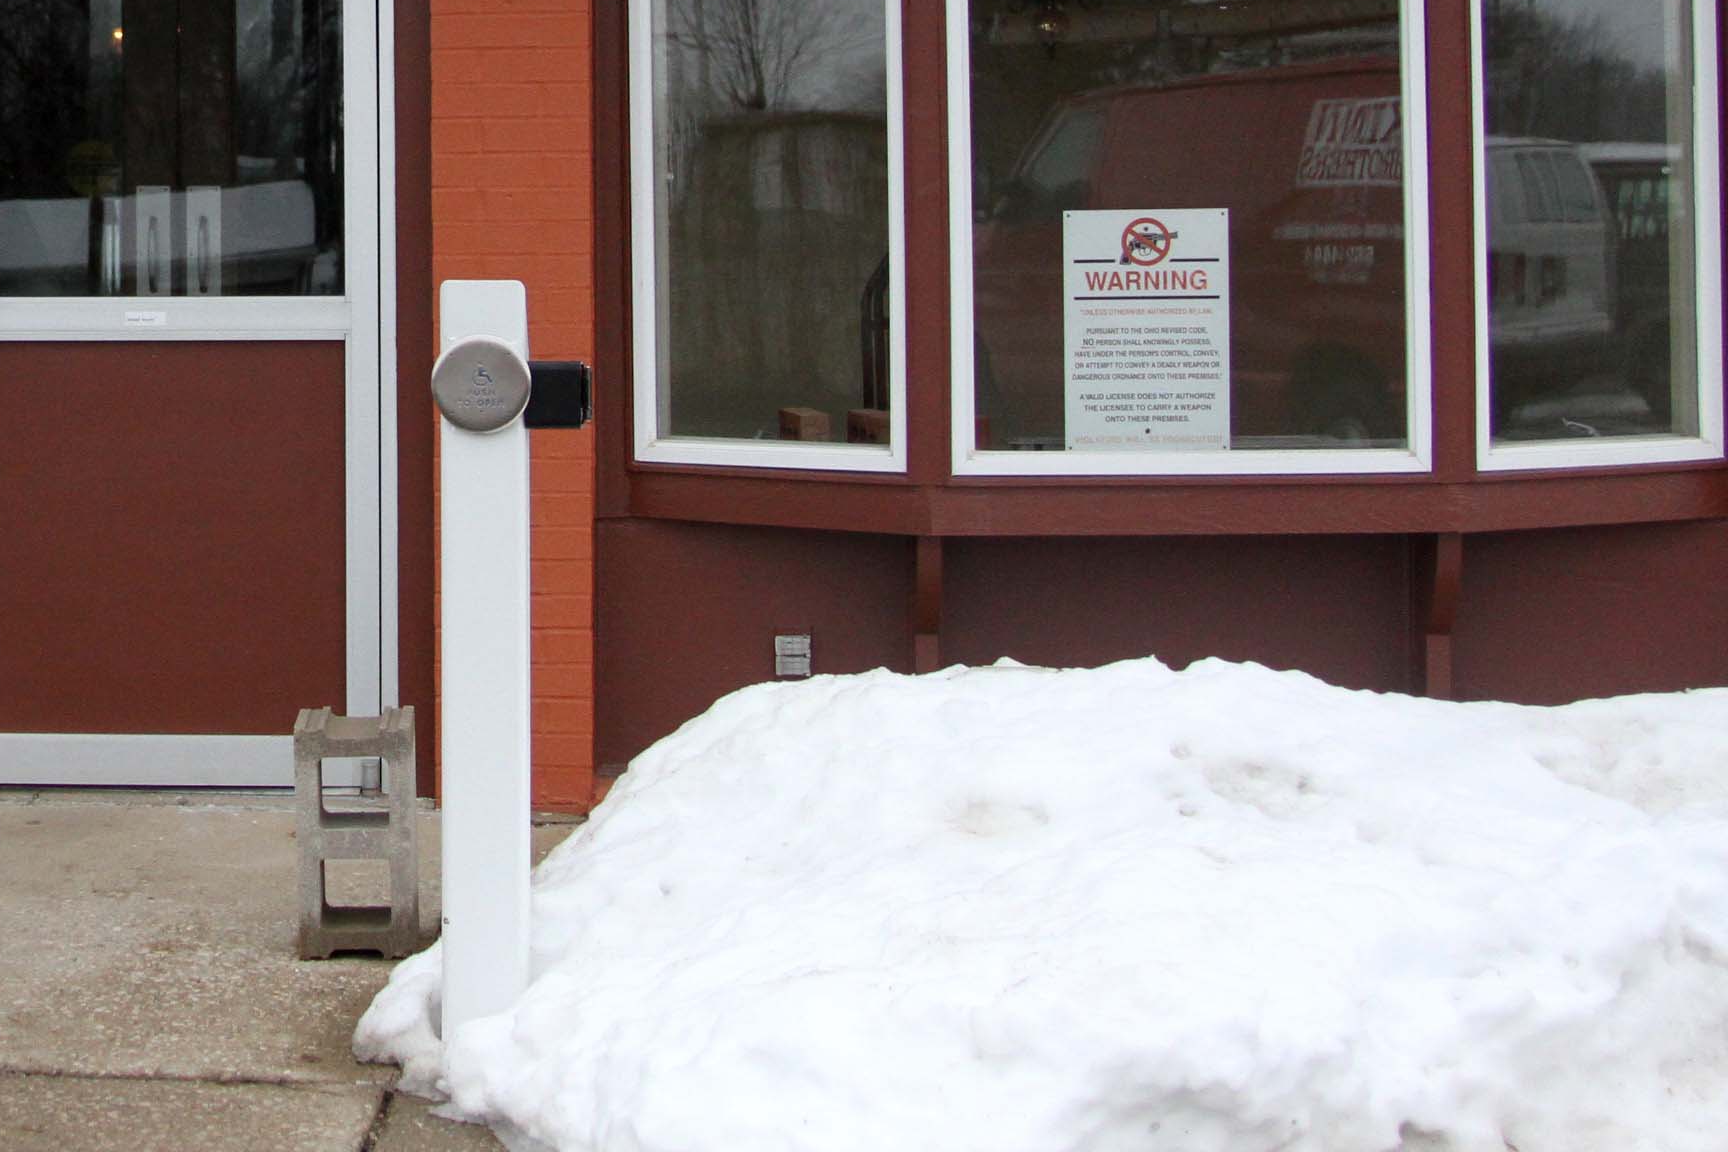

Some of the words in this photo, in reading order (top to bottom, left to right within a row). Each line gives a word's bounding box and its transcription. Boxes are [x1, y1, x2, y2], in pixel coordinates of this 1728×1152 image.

[1085, 270, 1208, 291] WARNING
[1083, 338, 1094, 346] NO
[1096, 338, 1121, 346] PERSON
[1123, 338, 1142, 346] SHALL
